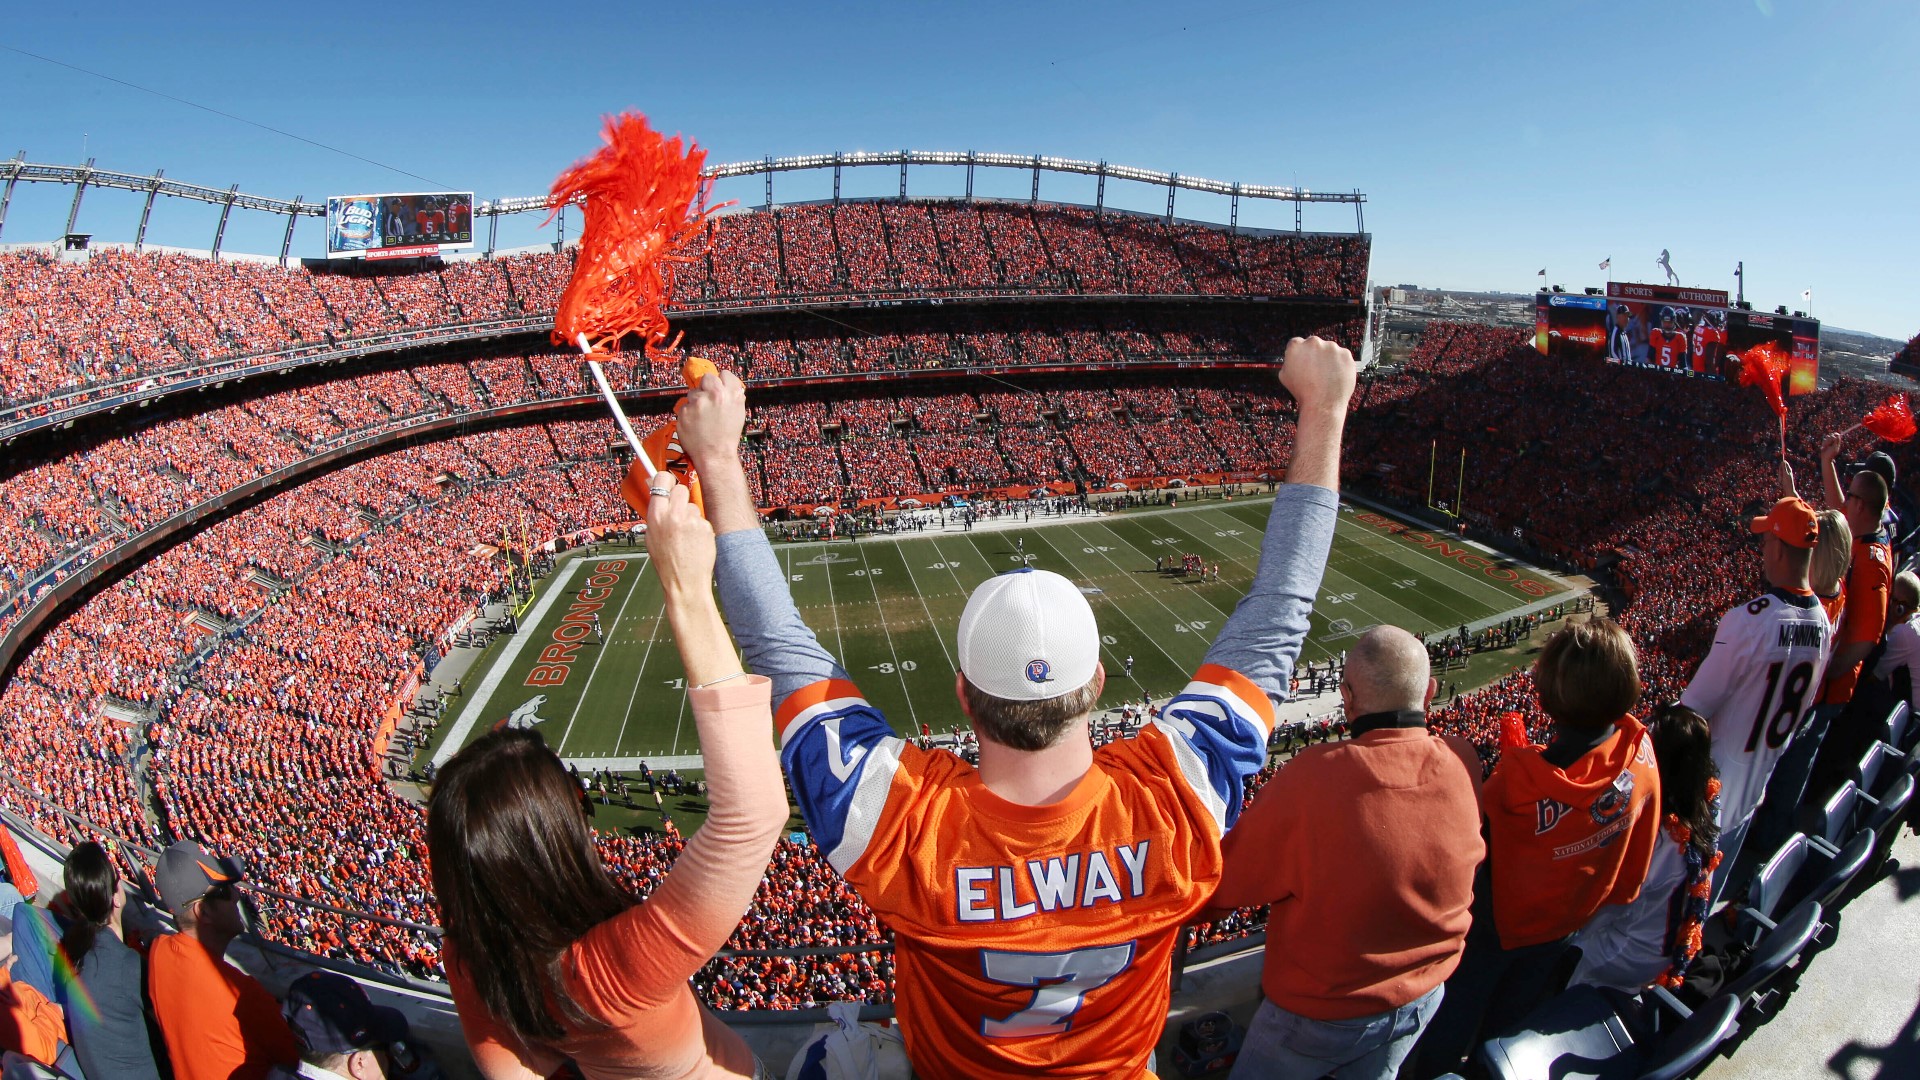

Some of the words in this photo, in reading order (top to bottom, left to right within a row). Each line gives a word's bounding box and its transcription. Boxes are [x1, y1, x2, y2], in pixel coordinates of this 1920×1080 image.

[345, 206, 372, 218] BUD
[338, 215, 374, 228] LIGHT
[426, 222, 434, 234] 5
[366, 250, 388, 258] SPORTS
[389, 248, 422, 257] AUTHORITY
[1624, 286, 1653, 297] SPORTS
[1678, 291, 1727, 304] AUTHORITY
[1748, 314, 1774, 326] GMC
[1660, 346, 1672, 366] 5
[1151, 538, 1178, 546] 30
[1082, 546, 1110, 554] 40
[1353, 512, 1554, 598] BRONCOS
[854, 568, 883, 577] 30
[932, 561, 961, 570] 40
[1392, 579, 1416, 589] 10
[1326, 592, 1356, 604] 20
[1746, 597, 1770, 616] 8
[523, 559, 628, 687] BRONCOS
[1174, 620, 1206, 634] 40
[1778, 624, 1822, 648] MANNING
[878, 660, 918, 675] 30
[1744, 661, 1814, 752] 18
[1554, 838, 1594, 858] NATIONAL
[955, 838, 1152, 924] ELWAY
[979, 939, 1138, 1039] 7
